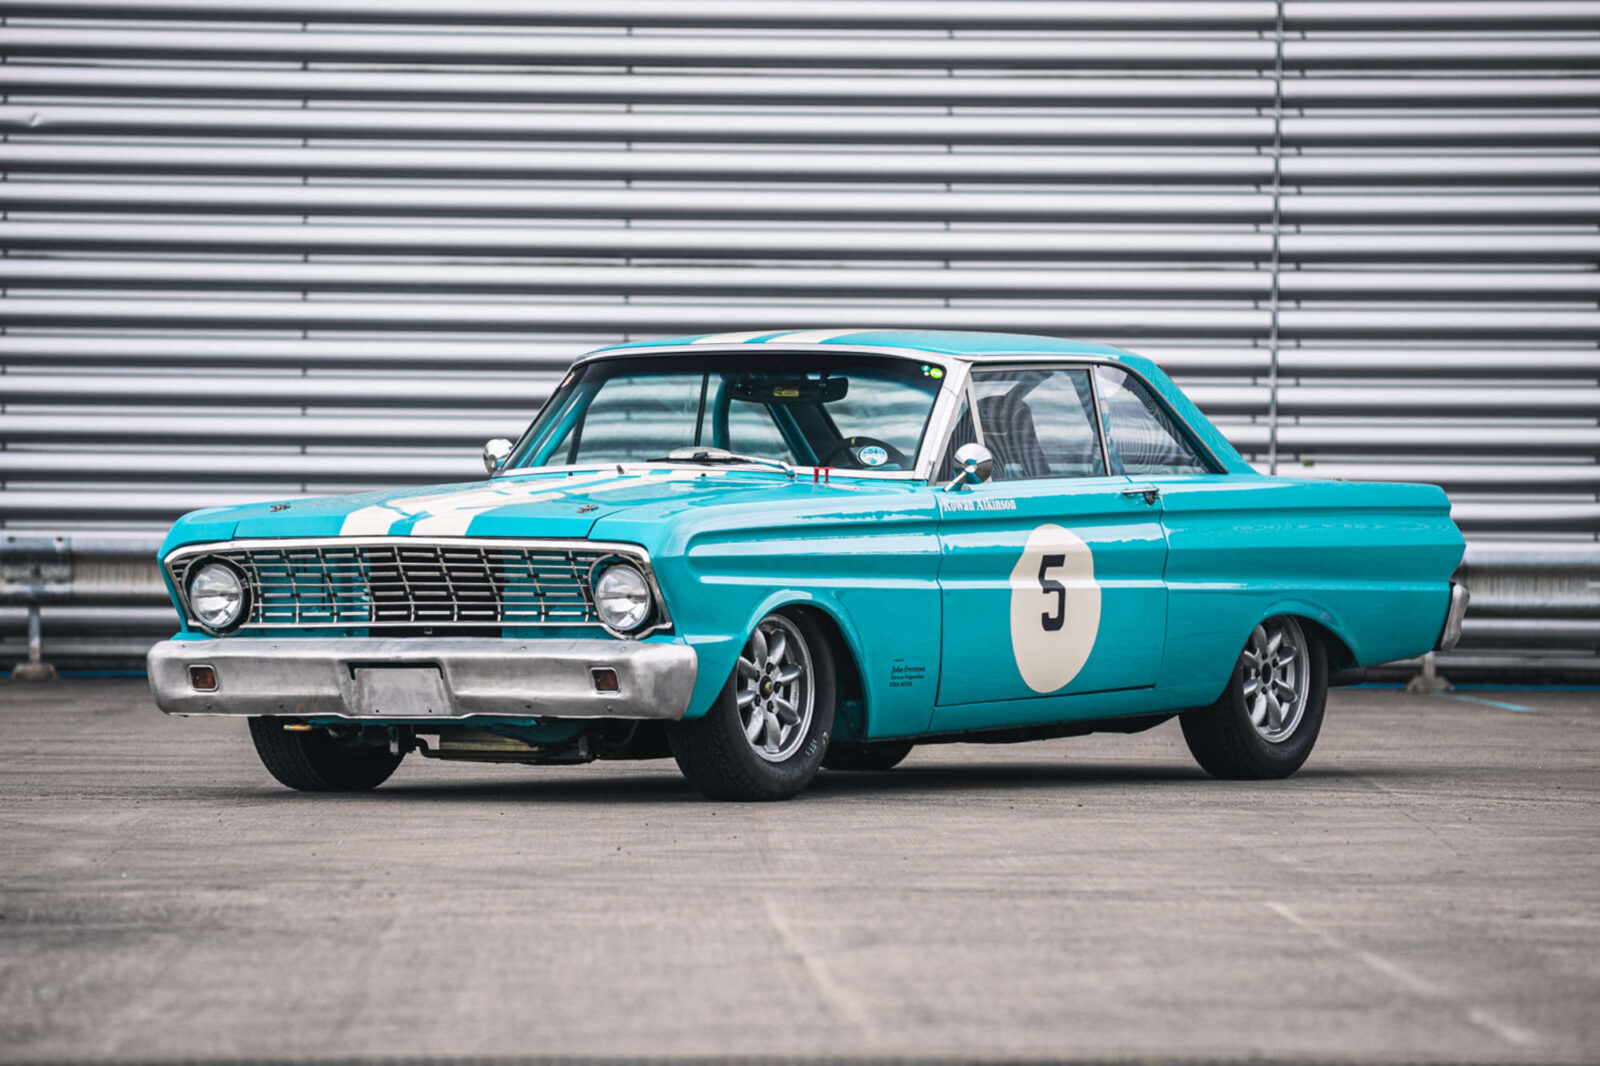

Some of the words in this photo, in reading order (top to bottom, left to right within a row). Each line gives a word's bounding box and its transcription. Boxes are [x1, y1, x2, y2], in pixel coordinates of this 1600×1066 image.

[943, 498, 976, 512] Rowan
[976, 498, 1017, 511] Atkinson
[1038, 554, 1066, 632] 5
